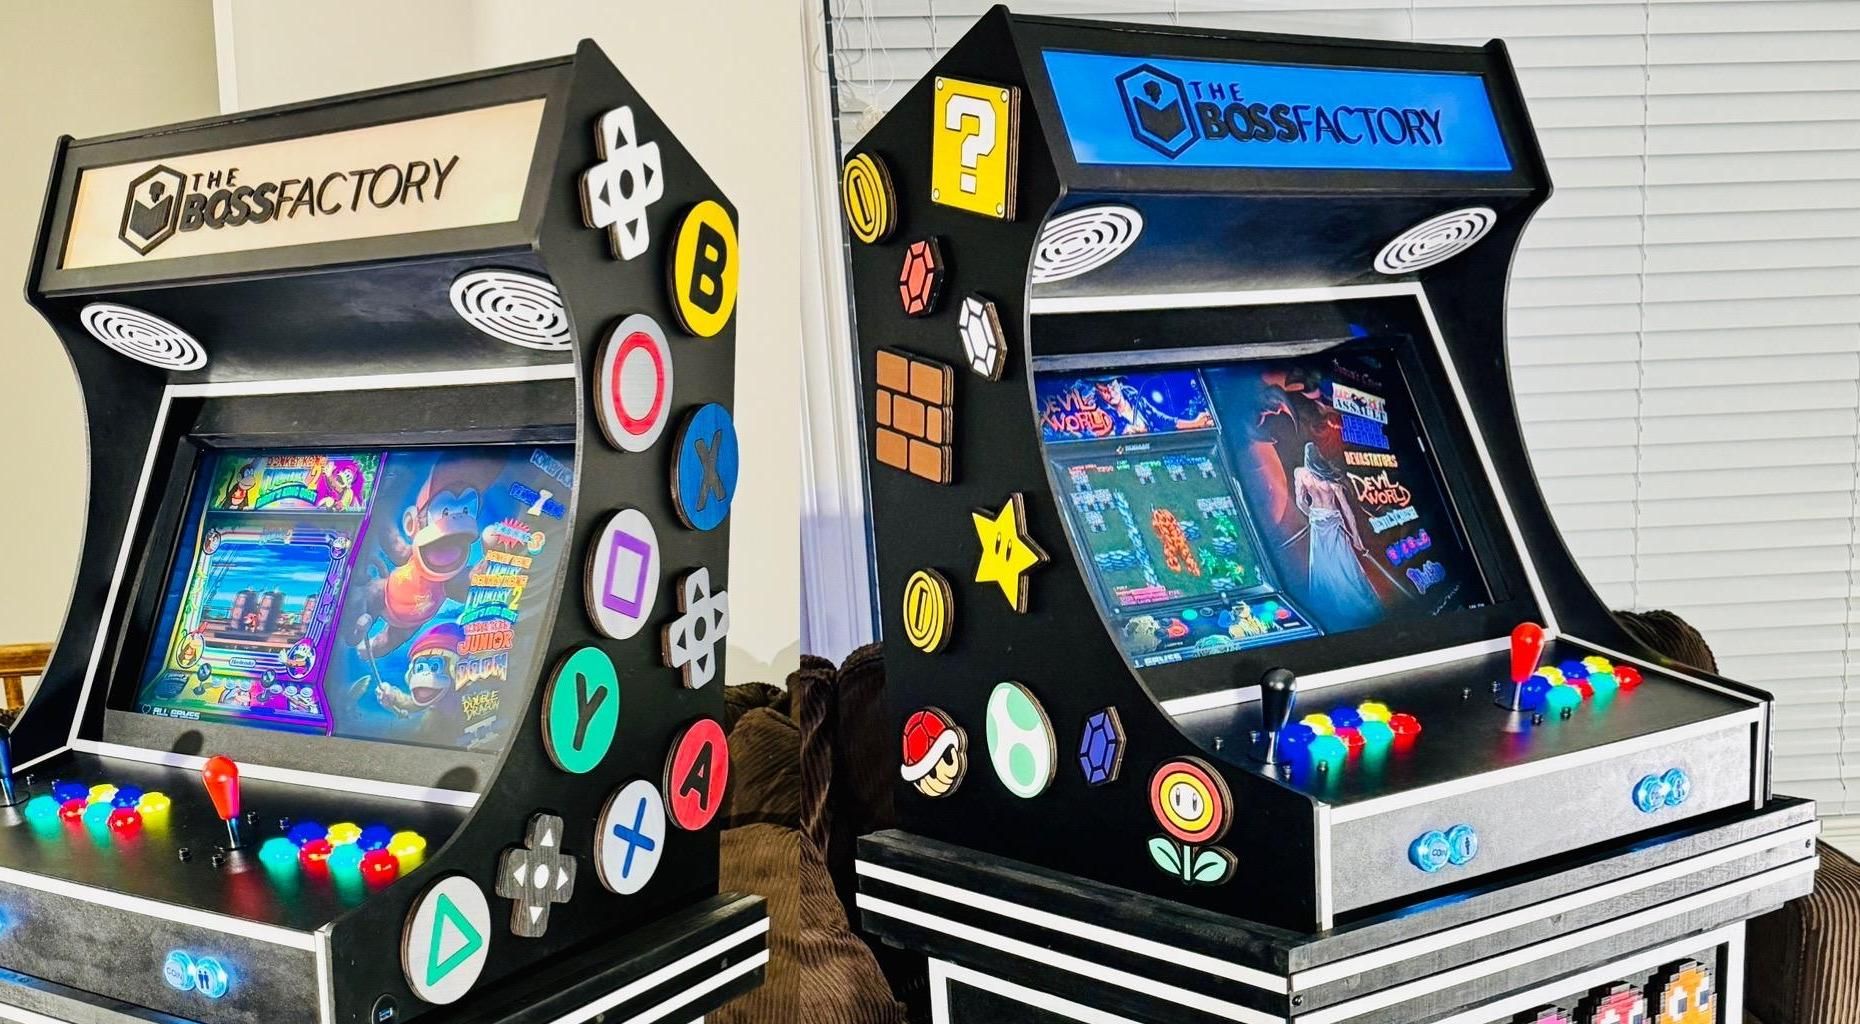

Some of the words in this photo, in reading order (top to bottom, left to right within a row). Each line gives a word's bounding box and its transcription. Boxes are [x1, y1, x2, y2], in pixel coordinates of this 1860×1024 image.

[1188, 81, 1244, 101] THE
[1196, 102, 1443, 145] BOSSFACTORY
[179, 155, 460, 232] BOSSFACTORY
[193, 167, 239, 190] THE
[689, 221, 728, 315] B
[1046, 408, 1113, 436] WORLD
[695, 430, 727, 511] X
[1346, 469, 1399, 502] DEVIL
[1364, 485, 1411, 507] WORLD
[457, 630, 514, 655] JUNIOR
[573, 672, 609, 751] Y
[680, 741, 713, 811] A
